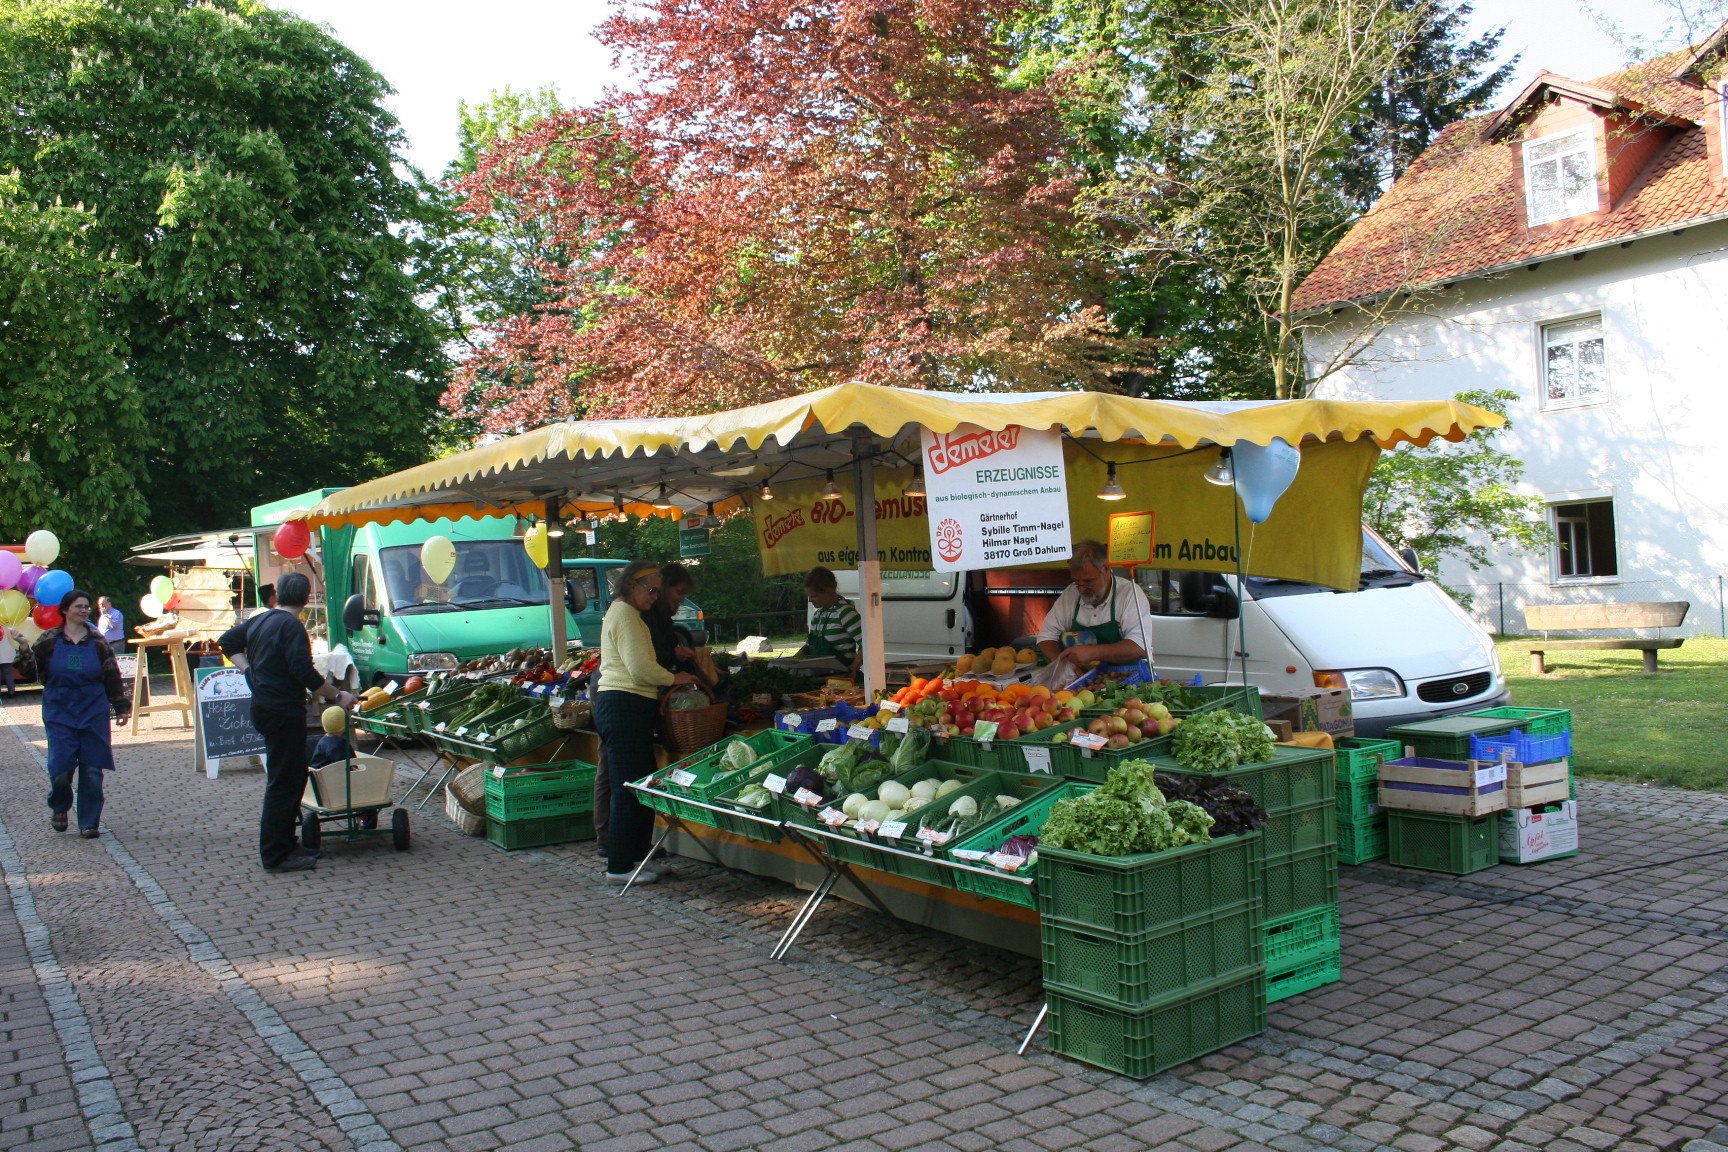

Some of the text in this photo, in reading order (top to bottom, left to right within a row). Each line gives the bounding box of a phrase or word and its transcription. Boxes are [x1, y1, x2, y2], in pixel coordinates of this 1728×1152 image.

[928, 425, 1020, 473] demeter
[976, 465, 1060, 484] ERZEUGNISSE
[935, 486, 1062, 503] aus biologisch-dynamischem Anbau
[979, 511, 1018, 522] Gärtnerhof
[936, 518, 963, 537] DEMETER
[981, 521, 1064, 537] Sybille Timm-Nagel
[982, 534, 1039, 548] Hilmar Nagel
[817, 550, 835, 563] aus
[983, 549, 1011, 561] 38170
[1013, 548, 1033, 558] Groß
[1035, 544, 1067, 556] Dahlum
[1178, 538, 1242, 563] Anbau
